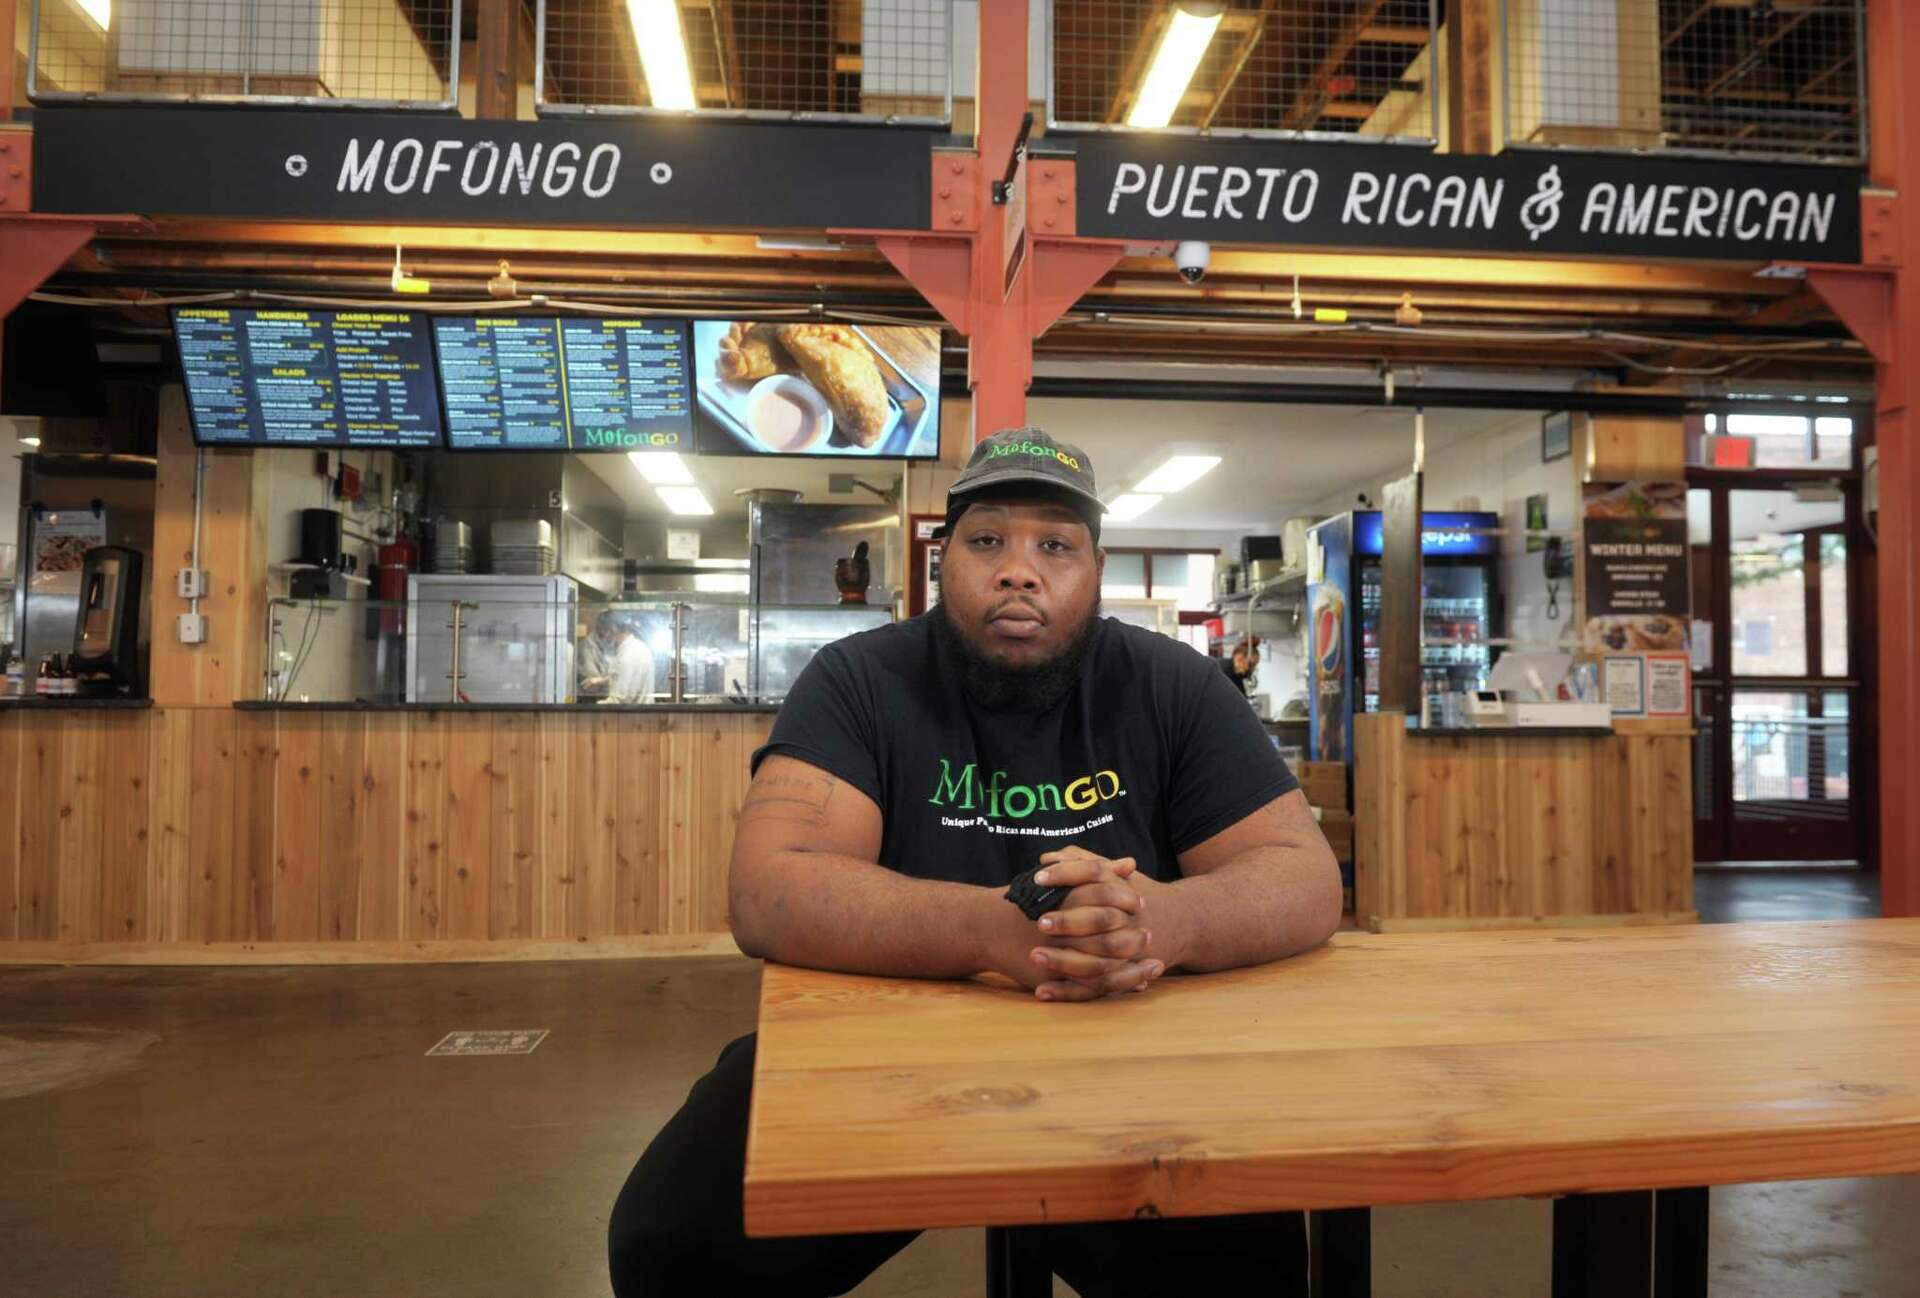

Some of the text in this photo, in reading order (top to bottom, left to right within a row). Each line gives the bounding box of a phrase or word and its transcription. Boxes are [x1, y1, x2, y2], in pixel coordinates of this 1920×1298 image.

[336, 138, 621, 198] MOFONGO
[1107, 163, 1834, 242] PUERTO RICAN & AMERICAN
[1421, 522, 1471, 546] epsi
[1590, 543, 1682, 557] WINTER MENU
[928, 759, 1120, 818] MfonGO
[941, 816, 975, 828] Unique
[1019, 826, 1040, 836] and
[1040, 824, 1086, 837] American
